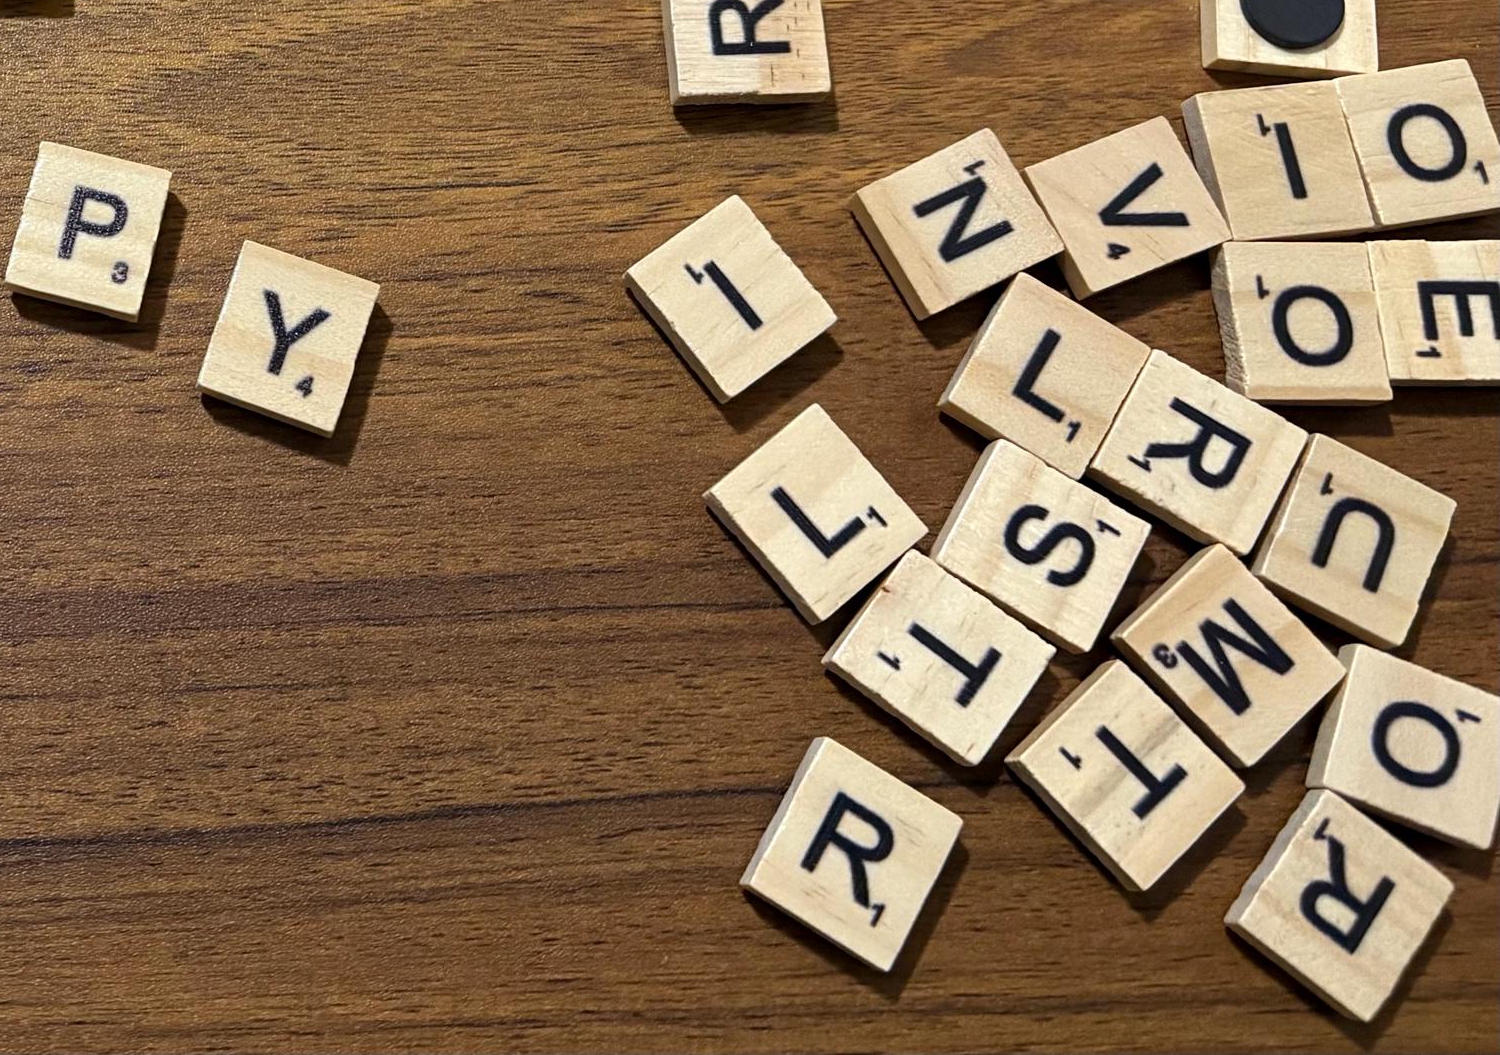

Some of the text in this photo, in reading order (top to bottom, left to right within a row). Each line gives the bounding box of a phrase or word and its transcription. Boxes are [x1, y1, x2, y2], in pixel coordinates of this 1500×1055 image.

[1256, 114, 1308, 200] I 1
[1387, 103, 1490, 184] O 1
[913, 160, 1014, 263] N 1
[1099, 163, 1189, 258] V 4
[683, 259, 763, 331] I 1
[1256, 275, 1354, 367] O 1
[1416, 281, 1500, 358] E 1
[1014, 328, 1082, 444] L 1
[1126, 397, 1253, 490] R 1
[771, 486, 888, 559] L 1
[1002, 503, 1122, 589] S 1
[1311, 472, 1396, 593] U 1
[876, 621, 1003, 709] T 1
[1153, 598, 1296, 718] M 3
[1059, 725, 1188, 820] T 1
[1371, 700, 1482, 790] O 1
[800, 790, 895, 928] R 1
[1298, 816, 1396, 954] R 1
